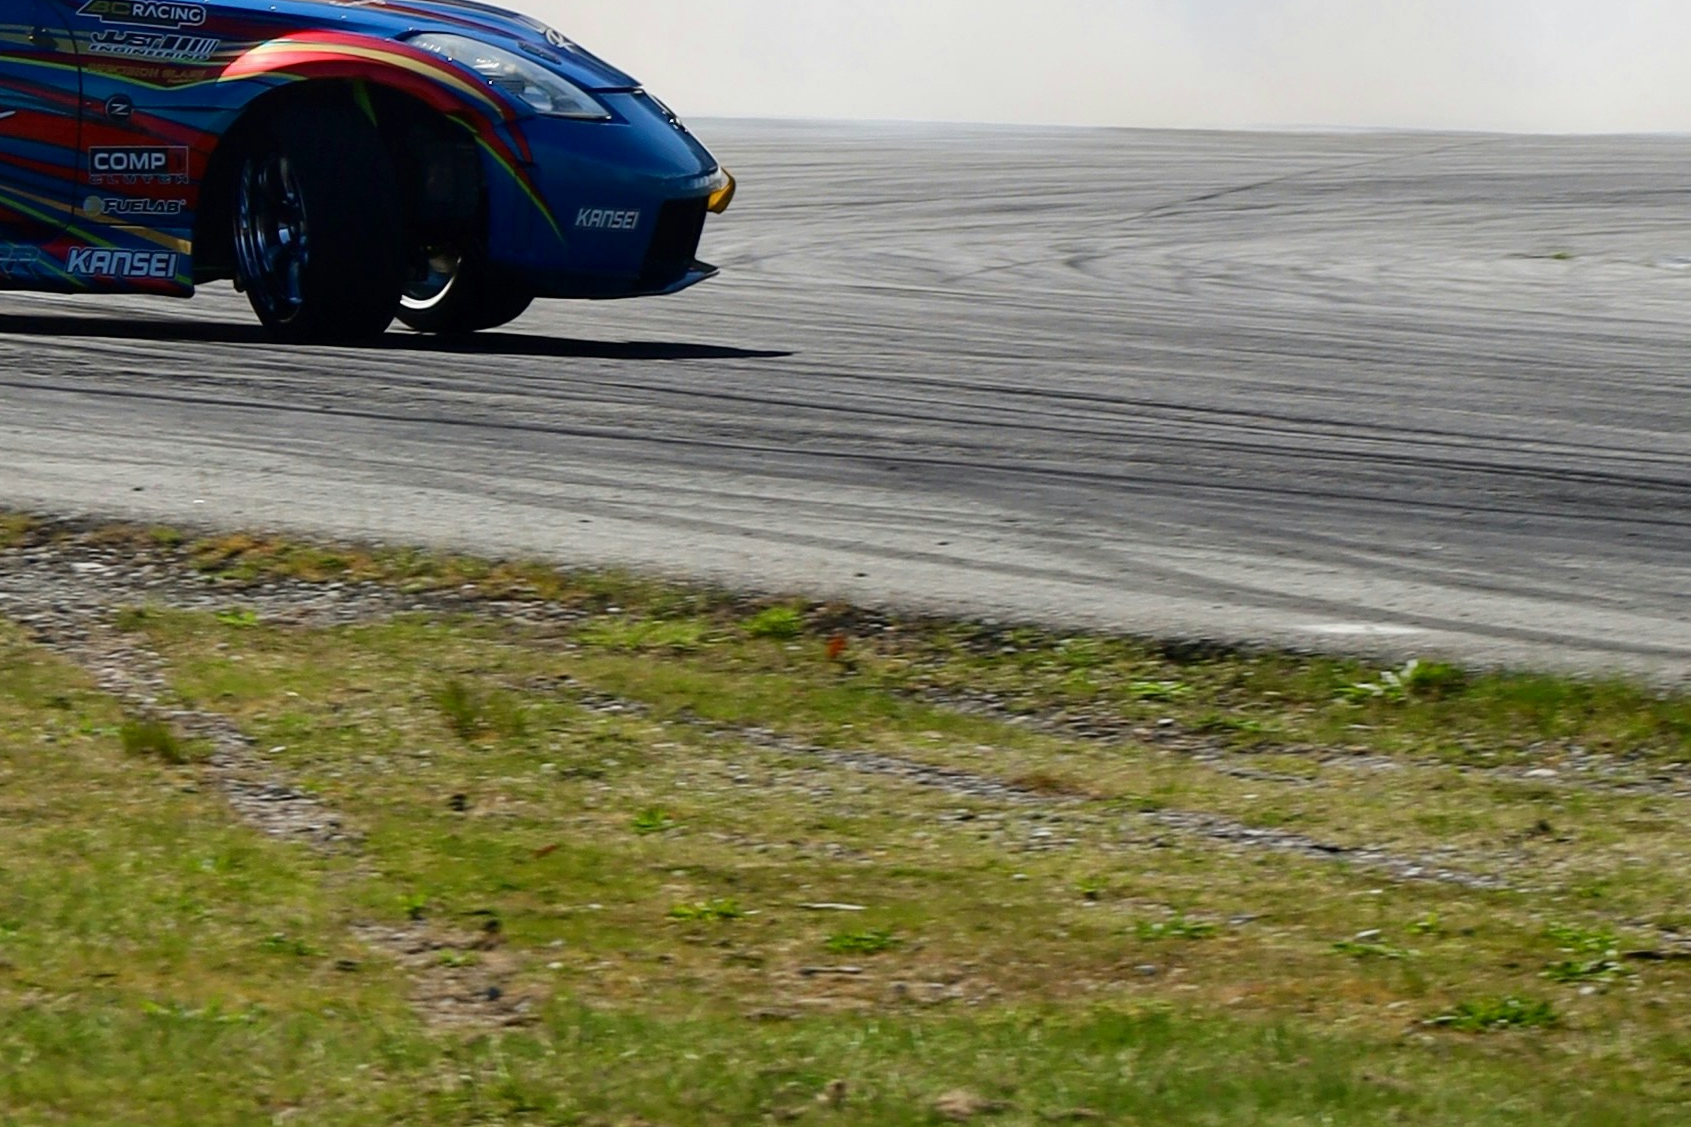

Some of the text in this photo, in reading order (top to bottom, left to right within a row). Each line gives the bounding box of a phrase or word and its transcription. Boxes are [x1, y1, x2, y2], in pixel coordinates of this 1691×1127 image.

[132, 3, 201, 21] RACING
[88, 43, 211, 60] ENGINEERING
[94, 153, 165, 170] COMP
[103, 199, 180, 214] FUELAB
[575, 208, 639, 229] KANSEI
[67, 249, 177, 277] KANSEI
